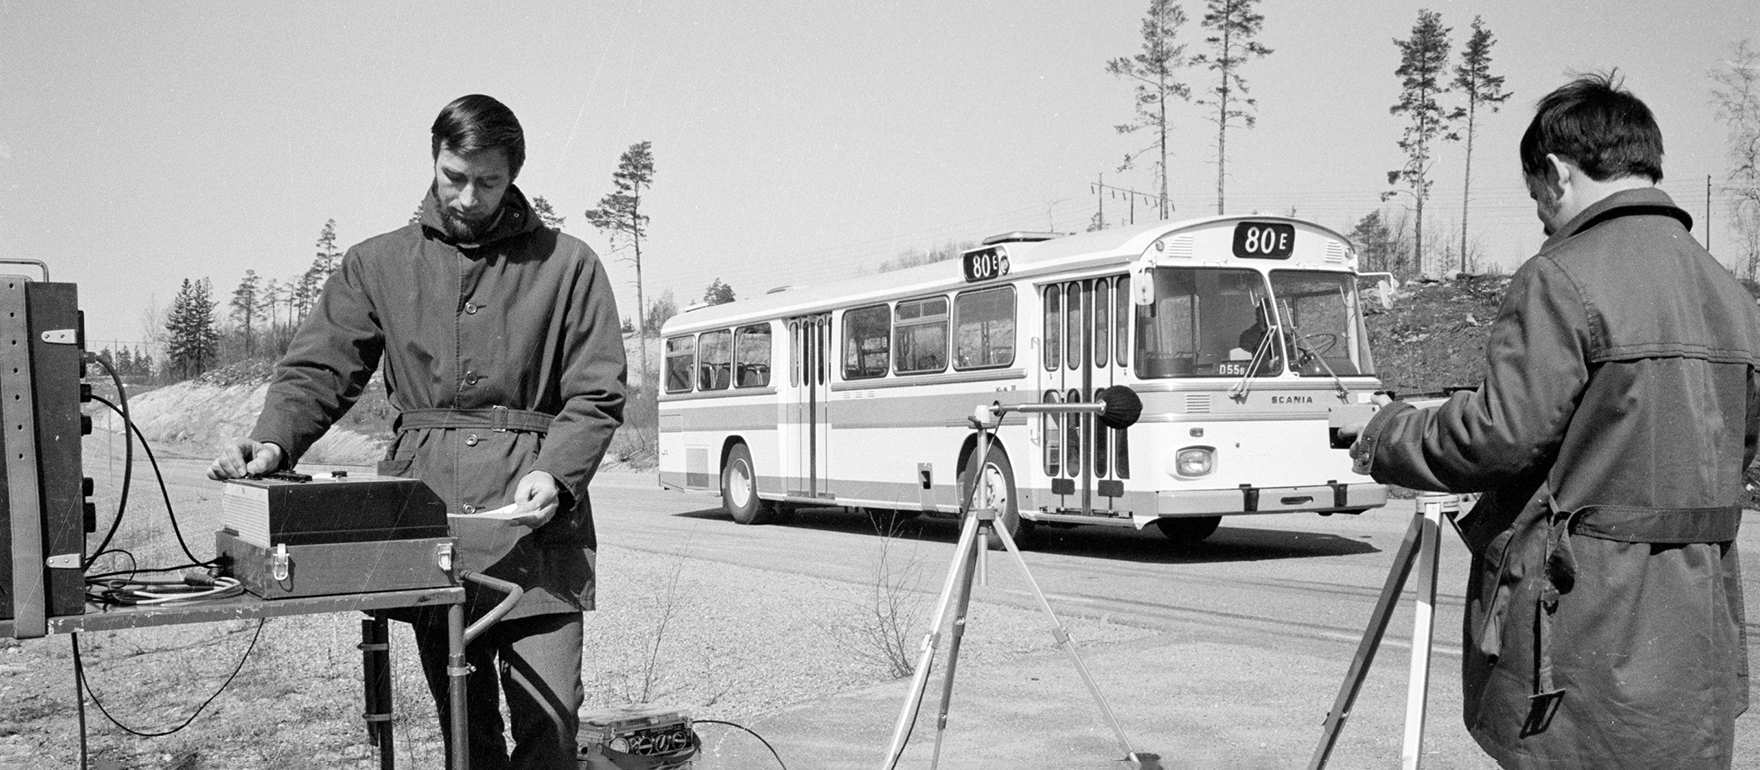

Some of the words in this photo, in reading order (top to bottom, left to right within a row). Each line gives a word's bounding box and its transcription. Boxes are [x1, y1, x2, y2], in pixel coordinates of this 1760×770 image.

[1245, 226, 1275, 254] 80
[1279, 233, 1288, 250] E
[973, 254, 990, 278] 80
[992, 255, 998, 270] E
[1271, 396, 1313, 404] SCANIA
